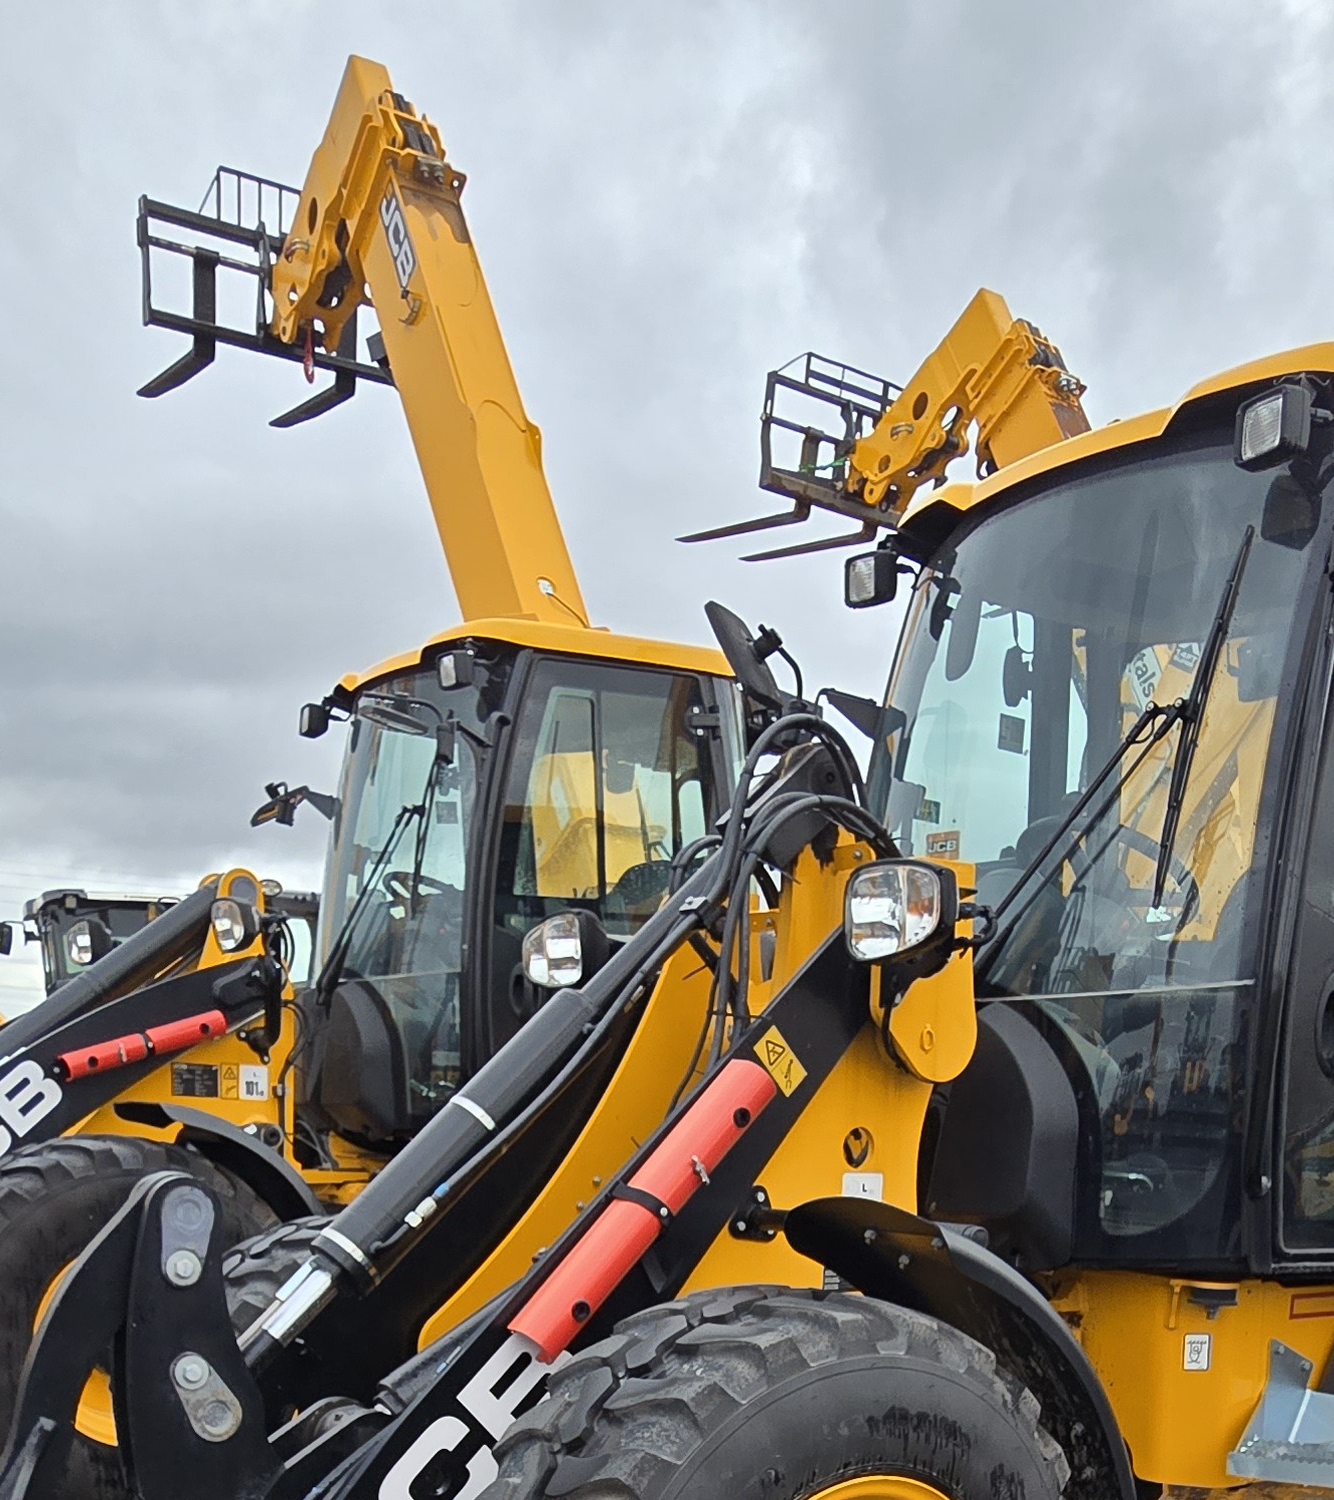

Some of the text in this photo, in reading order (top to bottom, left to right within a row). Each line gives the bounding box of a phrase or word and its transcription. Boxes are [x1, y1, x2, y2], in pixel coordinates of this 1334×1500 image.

[381, 197, 415, 288] JCB
[1133, 652, 1156, 698] tals
[928, 840, 957, 853] JCB
